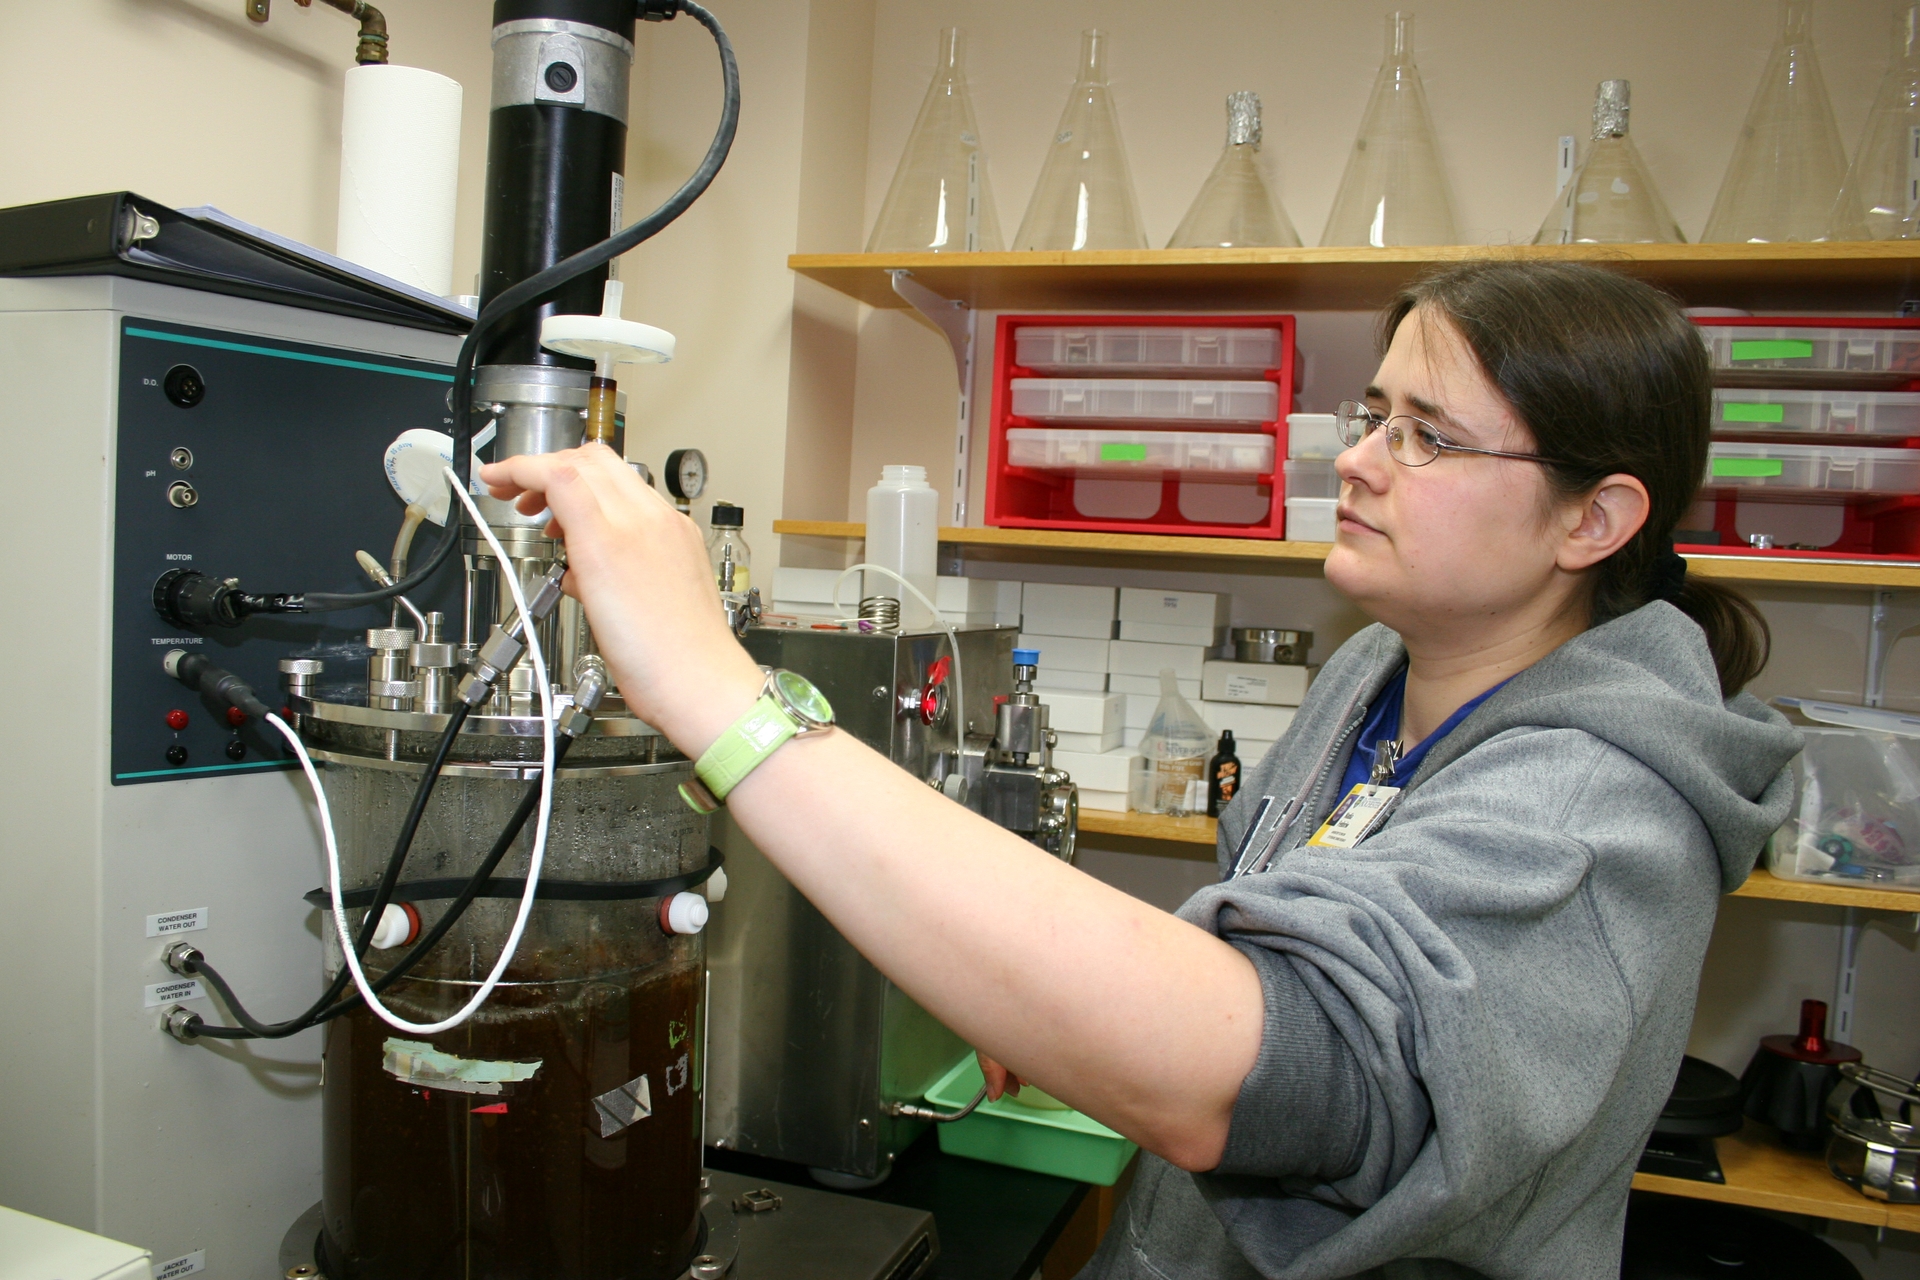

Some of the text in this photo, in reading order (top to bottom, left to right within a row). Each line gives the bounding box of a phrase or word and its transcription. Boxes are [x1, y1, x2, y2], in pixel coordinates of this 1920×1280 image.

[143, 378, 159, 387] D.O.
[146, 470, 157, 478] pH
[166, 553, 193, 561] MOTOR
[151, 638, 204, 646] TEMPERATURE
[157, 912, 198, 924] CONDENSER
[158, 921, 196, 931] WATER OUT
[156, 981, 196, 994] CONDENSER
[160, 991, 184, 1001] WATER
[163, 1258, 188, 1272] JACKET
[156, 1264, 194, 1280] WATER OUT
